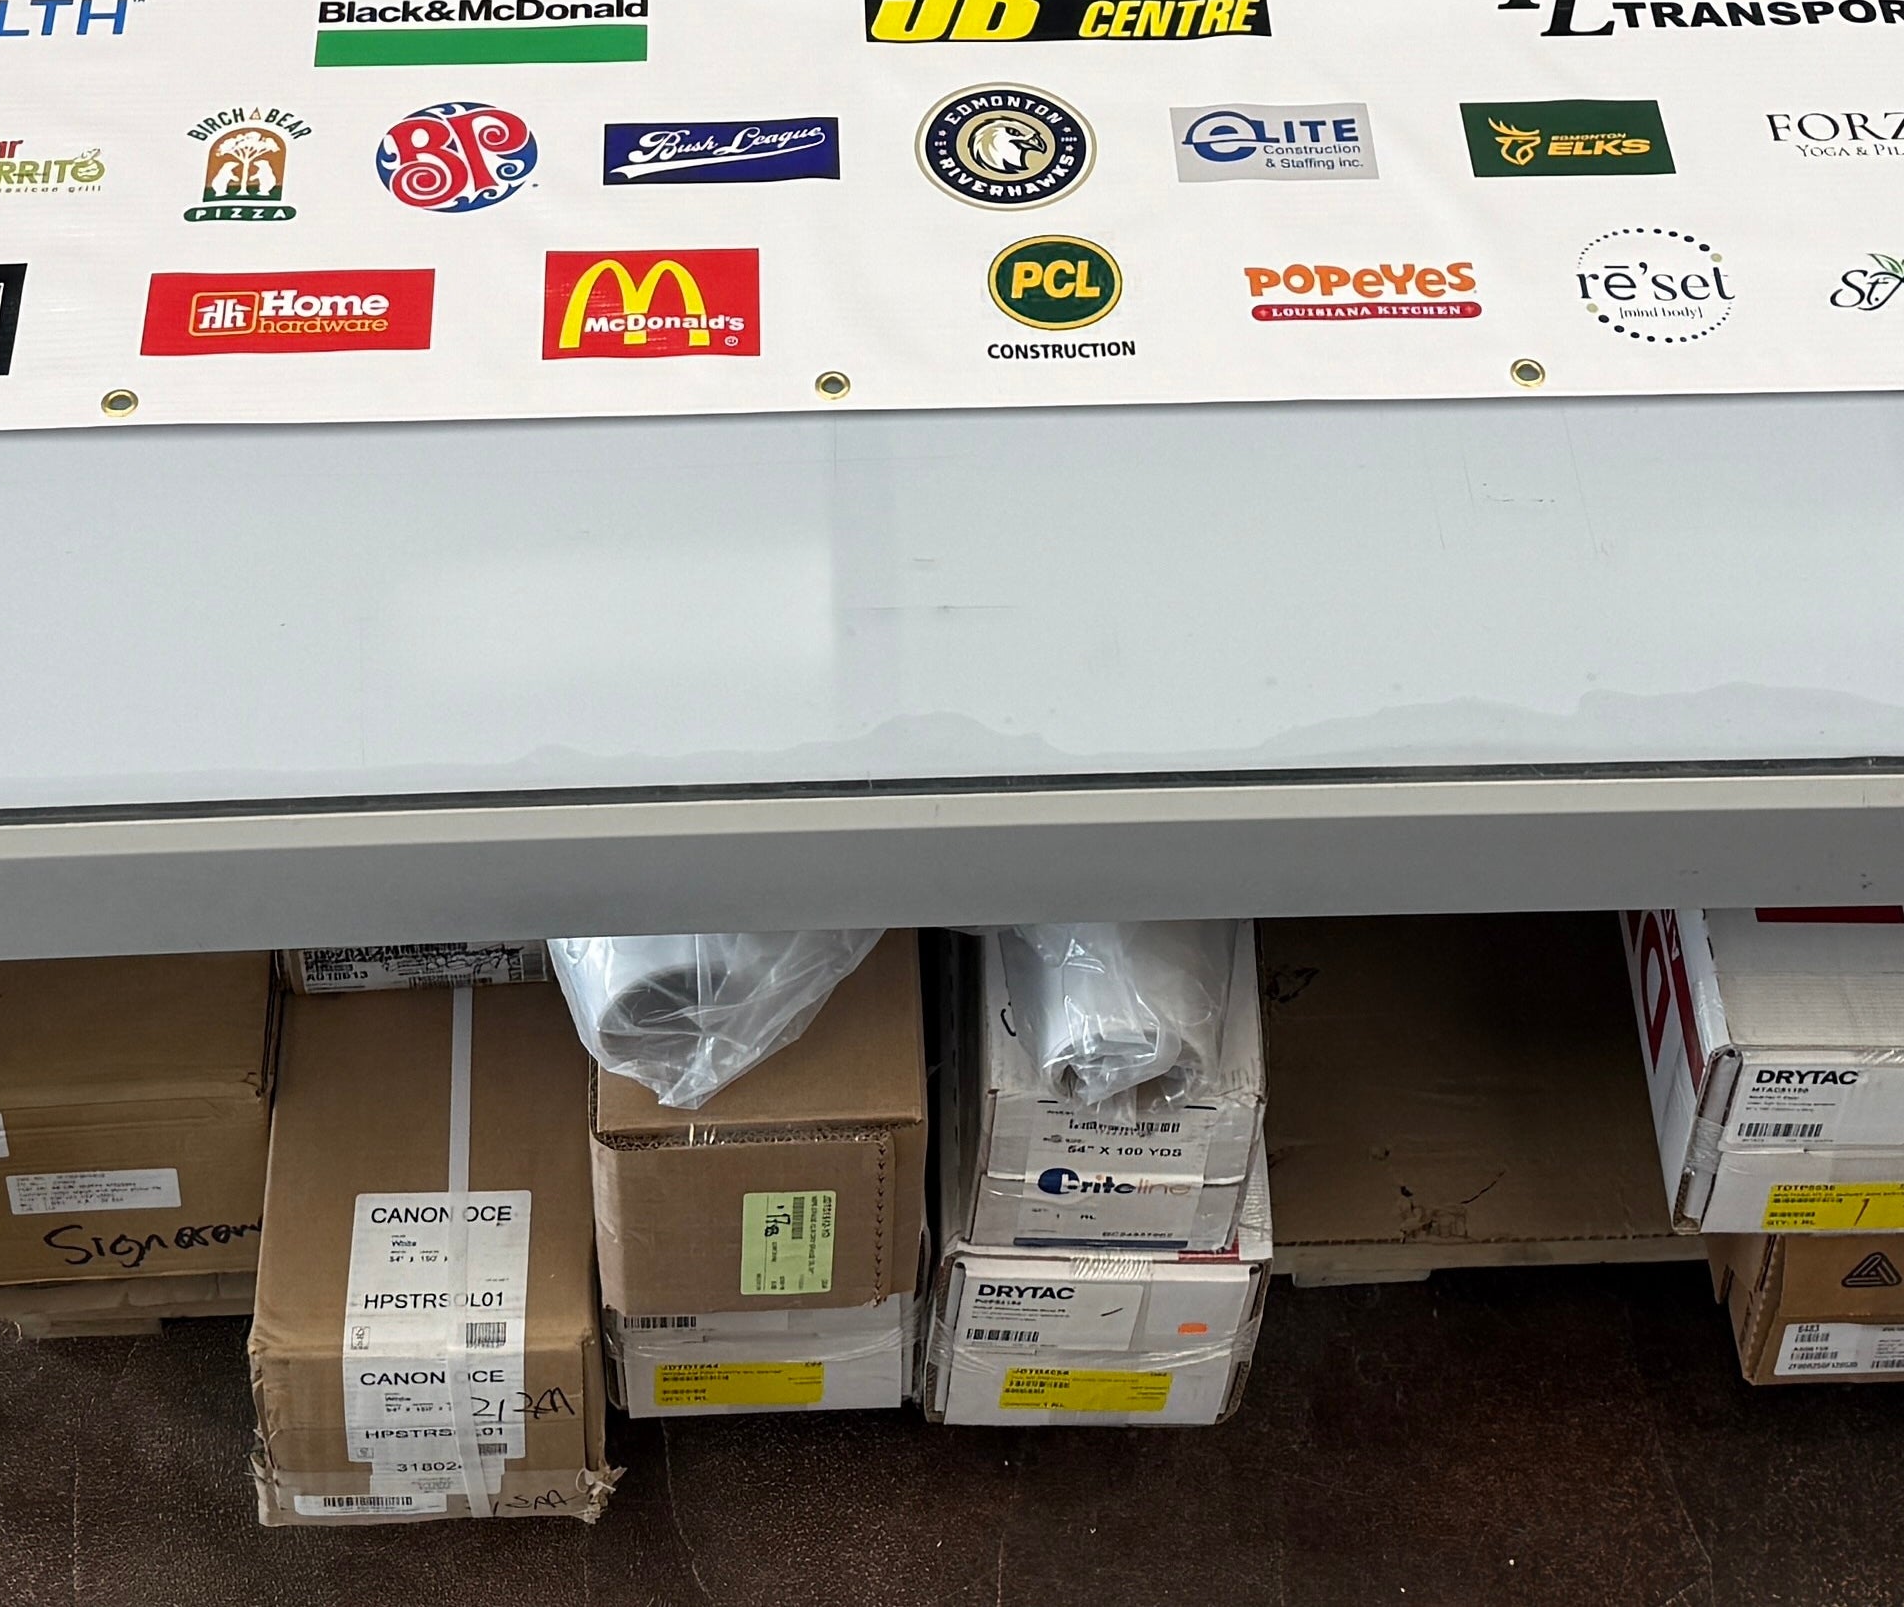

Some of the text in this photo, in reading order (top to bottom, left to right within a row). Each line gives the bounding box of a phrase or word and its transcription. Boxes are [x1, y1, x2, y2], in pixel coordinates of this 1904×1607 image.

[944, 95, 1063, 125] EDMONTON
[187, 107, 313, 142] BIRCH BEAR
[628, 125, 826, 164] Bush League
[1551, 133, 1627, 141] EDMONTON
[1263, 145, 1361, 155] Construction
[1548, 139, 1651, 156] ELKS
[1266, 158, 1276, 168] &
[1281, 157, 1335, 169] Staffing
[939, 154, 1075, 197] RIVERHAWKS
[195, 207, 288, 221] PIZZA
[1010, 259, 1102, 300] PCL
[258, 290, 389, 317] Home
[1271, 304, 1462, 318] LOUISIANA KITCHEN
[257, 316, 389, 334] hardware
[584, 315, 746, 334] McDonald's
[987, 341, 1136, 360] CONSTRUCTION
[1755, 1069, 1859, 1085] DRYTAC
[1099, 1147, 1110, 1155] X
[1117, 1147, 1143, 1156] 100
[371, 1205, 512, 1224] CANON OCE
[977, 1284, 1075, 1300] DRYTAC
[360, 1372, 446, 1386] CANON
